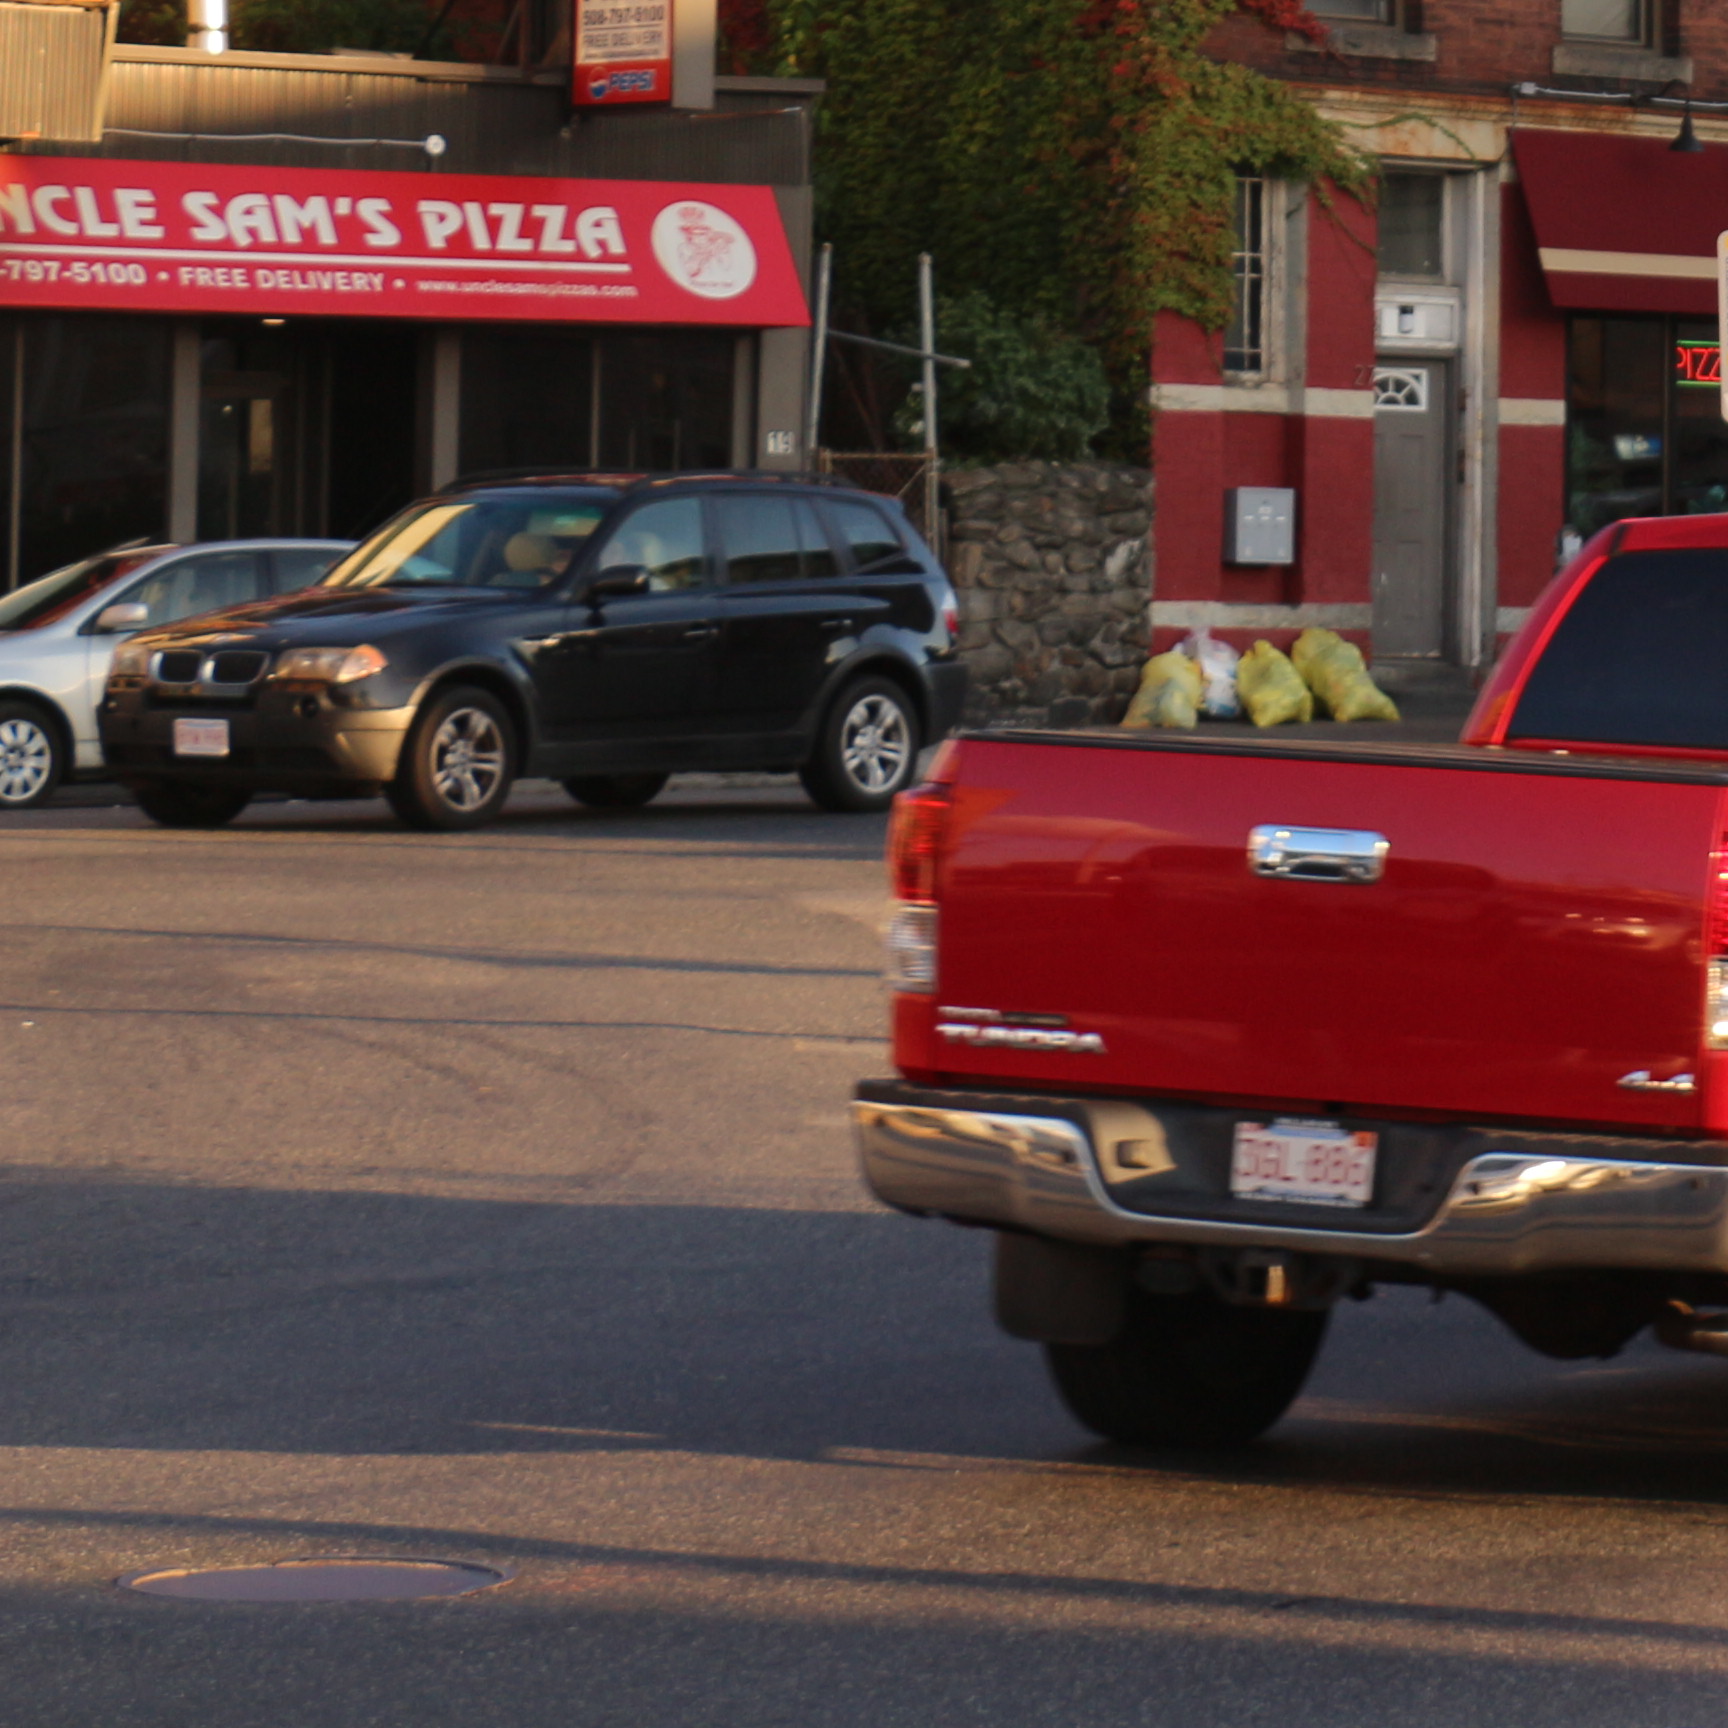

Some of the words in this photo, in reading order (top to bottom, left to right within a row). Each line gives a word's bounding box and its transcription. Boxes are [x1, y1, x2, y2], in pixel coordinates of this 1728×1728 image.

[608, 70, 657, 94] PEPSI
[181, 191, 401, 248] SAM'S
[416, 199, 628, 259] PIZZA
[178, 266, 250, 288] FREE
[254, 268, 385, 293] DELIVERY
